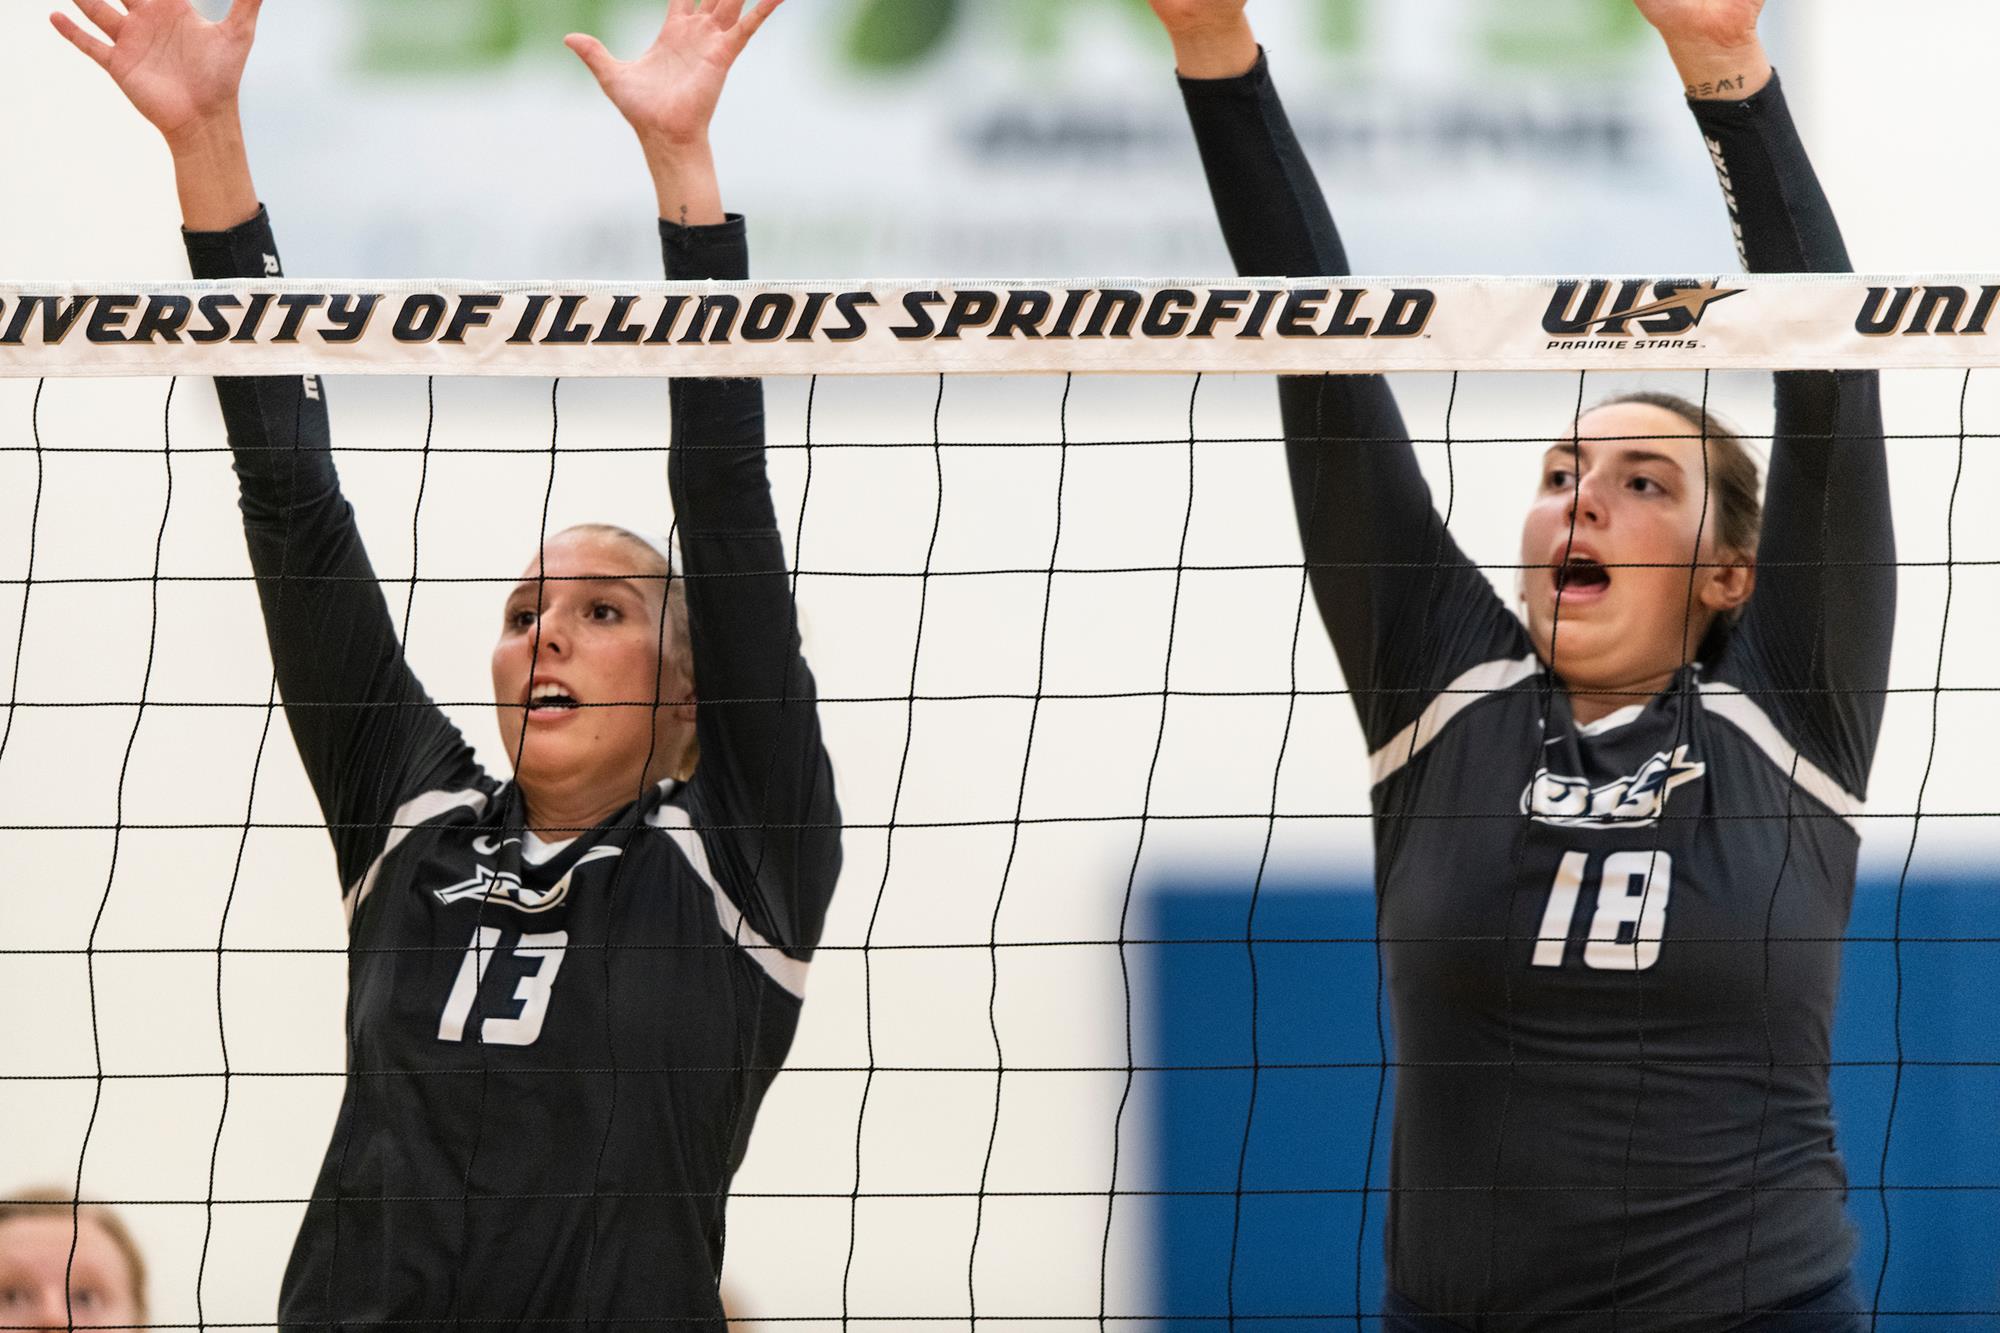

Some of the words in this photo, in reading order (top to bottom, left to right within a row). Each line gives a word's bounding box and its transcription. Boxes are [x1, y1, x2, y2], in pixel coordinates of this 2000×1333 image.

[0, 293, 385, 346] IVERSITY
[392, 293, 505, 345] OF
[505, 290, 881, 346] ILLINOIS
[889, 288, 1437, 341] SPRINGFIELD
[1541, 278, 1748, 337] UIS
[1855, 285, 2000, 338] UNI
[1546, 340, 1629, 350] PRAIRIE
[1633, 339, 1699, 349] STARS
[1531, 850, 1672, 971] 18
[437, 925, 569, 1047] 13
